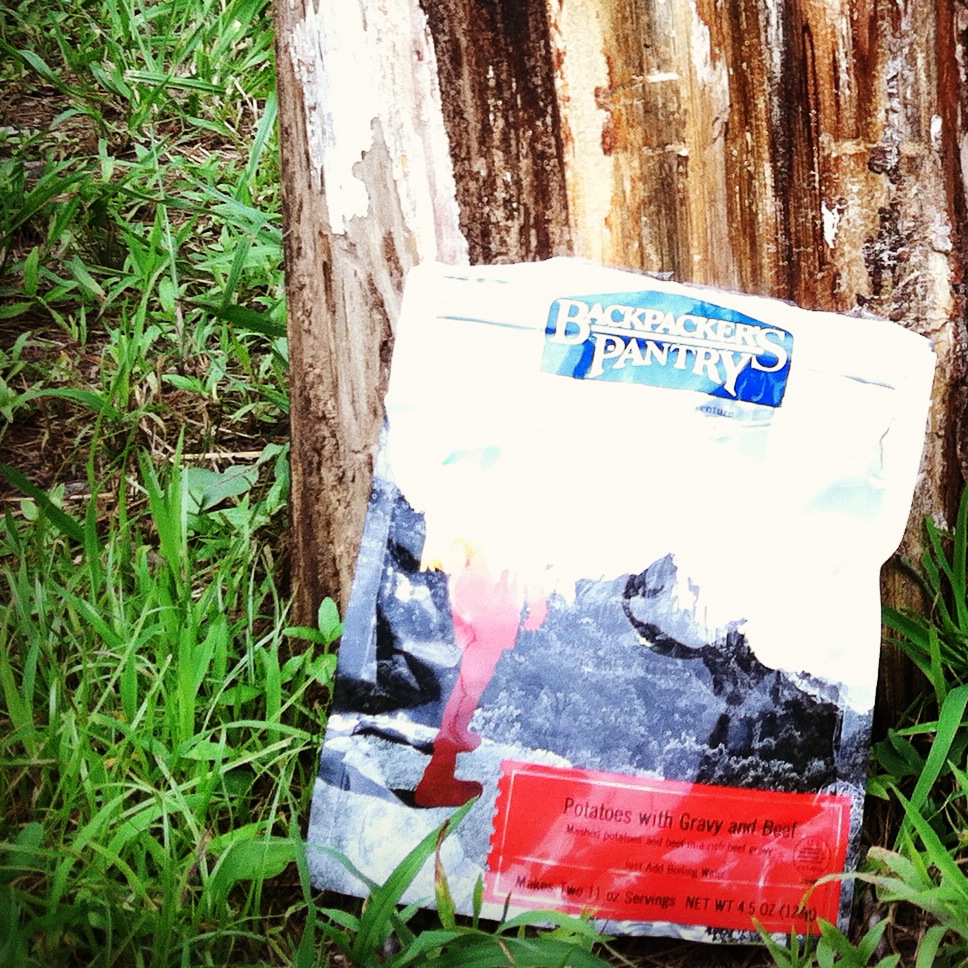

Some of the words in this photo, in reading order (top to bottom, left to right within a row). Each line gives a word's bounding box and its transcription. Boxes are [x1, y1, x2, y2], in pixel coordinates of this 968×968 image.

[554, 298, 788, 372] BACKPACKER'S
[587, 332, 752, 398] PANTRY
[563, 797, 632, 824] Potatoes
[639, 810, 673, 829] with
[679, 812, 723, 836] Gravy
[729, 818, 757, 835] and
[761, 819, 798, 838] Beef
[645, 862, 664, 872] Add
[516, 875, 554, 891] Makes
[560, 881, 583, 897] Two
[606, 891, 619, 902] oz
[624, 890, 676, 909] Servings
[685, 895, 712, 910] NET
[715, 899, 734, 914] WT
[759, 903, 776, 917] OZ
